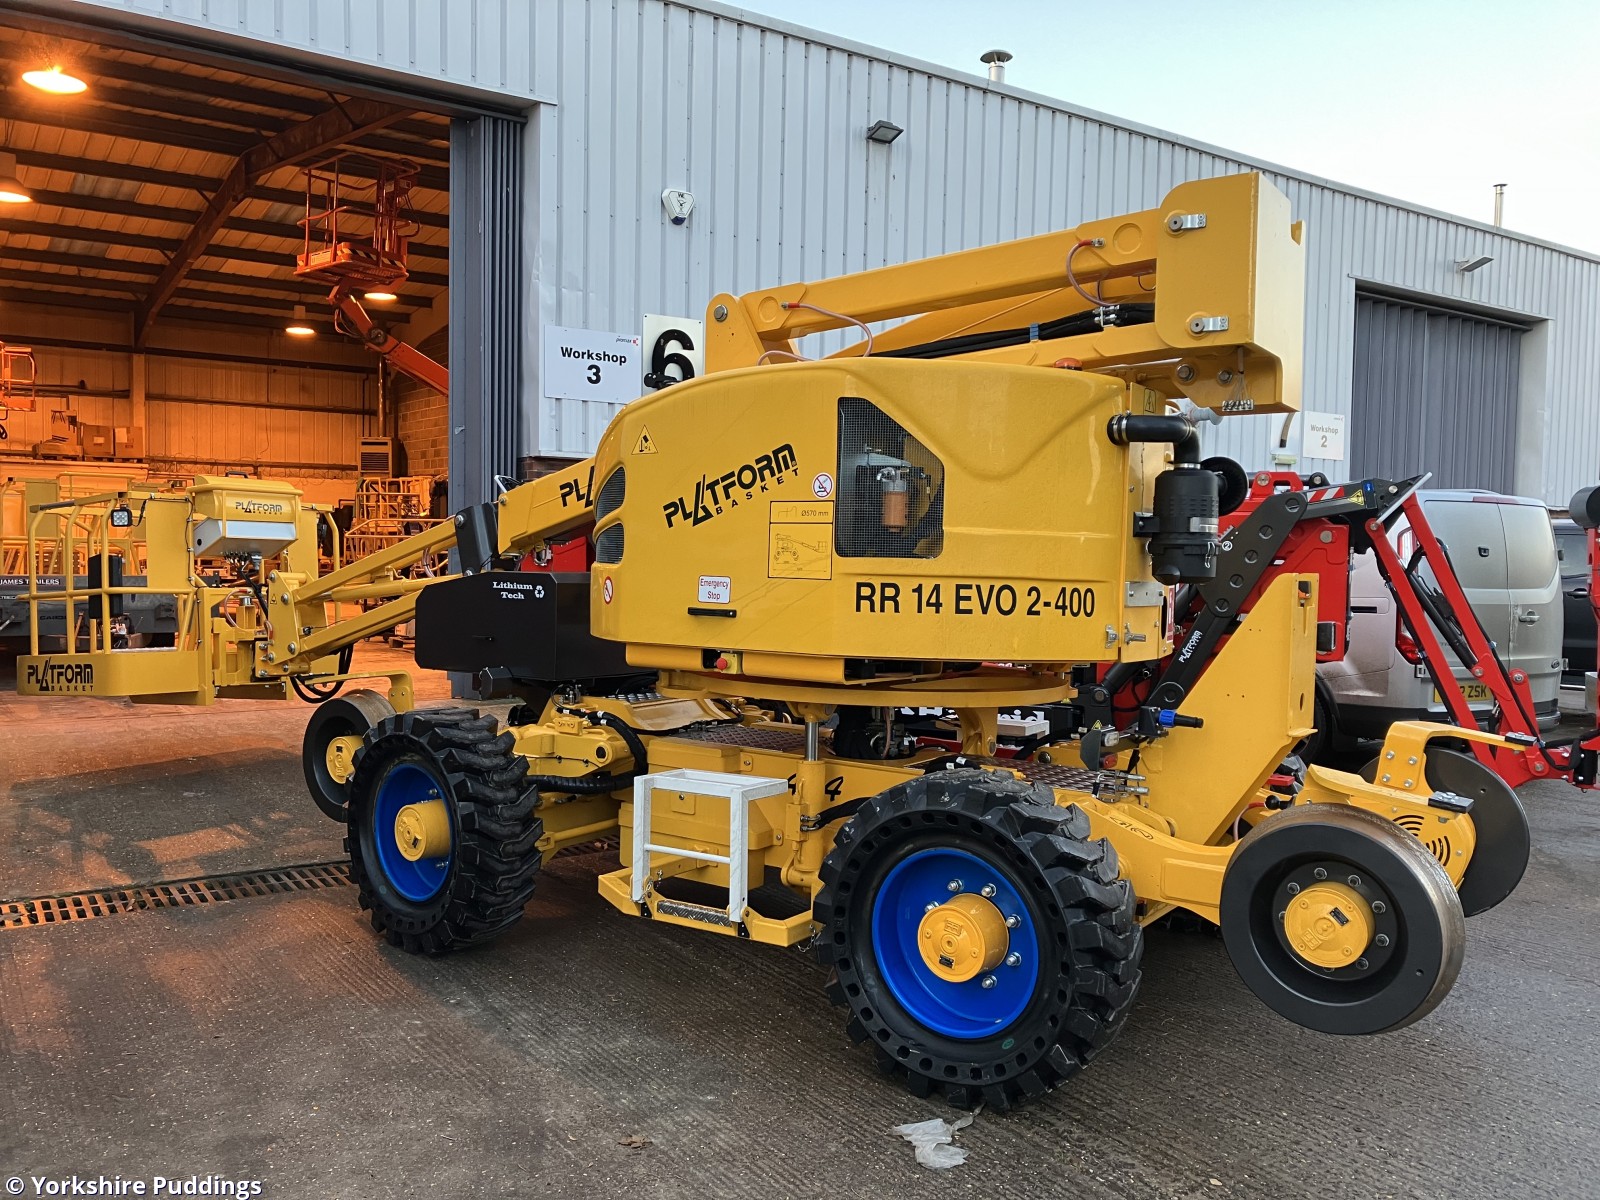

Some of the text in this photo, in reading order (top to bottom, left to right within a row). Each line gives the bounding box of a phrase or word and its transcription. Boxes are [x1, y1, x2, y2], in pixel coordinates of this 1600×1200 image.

[560, 346, 627, 366] Workshop
[652, 329, 695, 383] 6
[586, 364, 602, 385] 3
[1310, 424, 1339, 435] Workshop
[1320, 434, 1328, 448] 2
[662, 443, 798, 528] PLATFORM
[715, 467, 799, 515] BASKET
[235, 500, 283, 513] PLATFORM
[492, 581, 533, 590] Lithium
[700, 578, 729, 590] Emergency
[500, 591, 525, 599] Tech
[707, 590, 721, 601] Stop
[855, 581, 1095, 618] RR 14 EVO 2-400
[1178, 630, 1203, 663] PLATFORM
[27, 656, 94, 691] PLATFORM
[1467, 685, 1487, 699] ZSK
